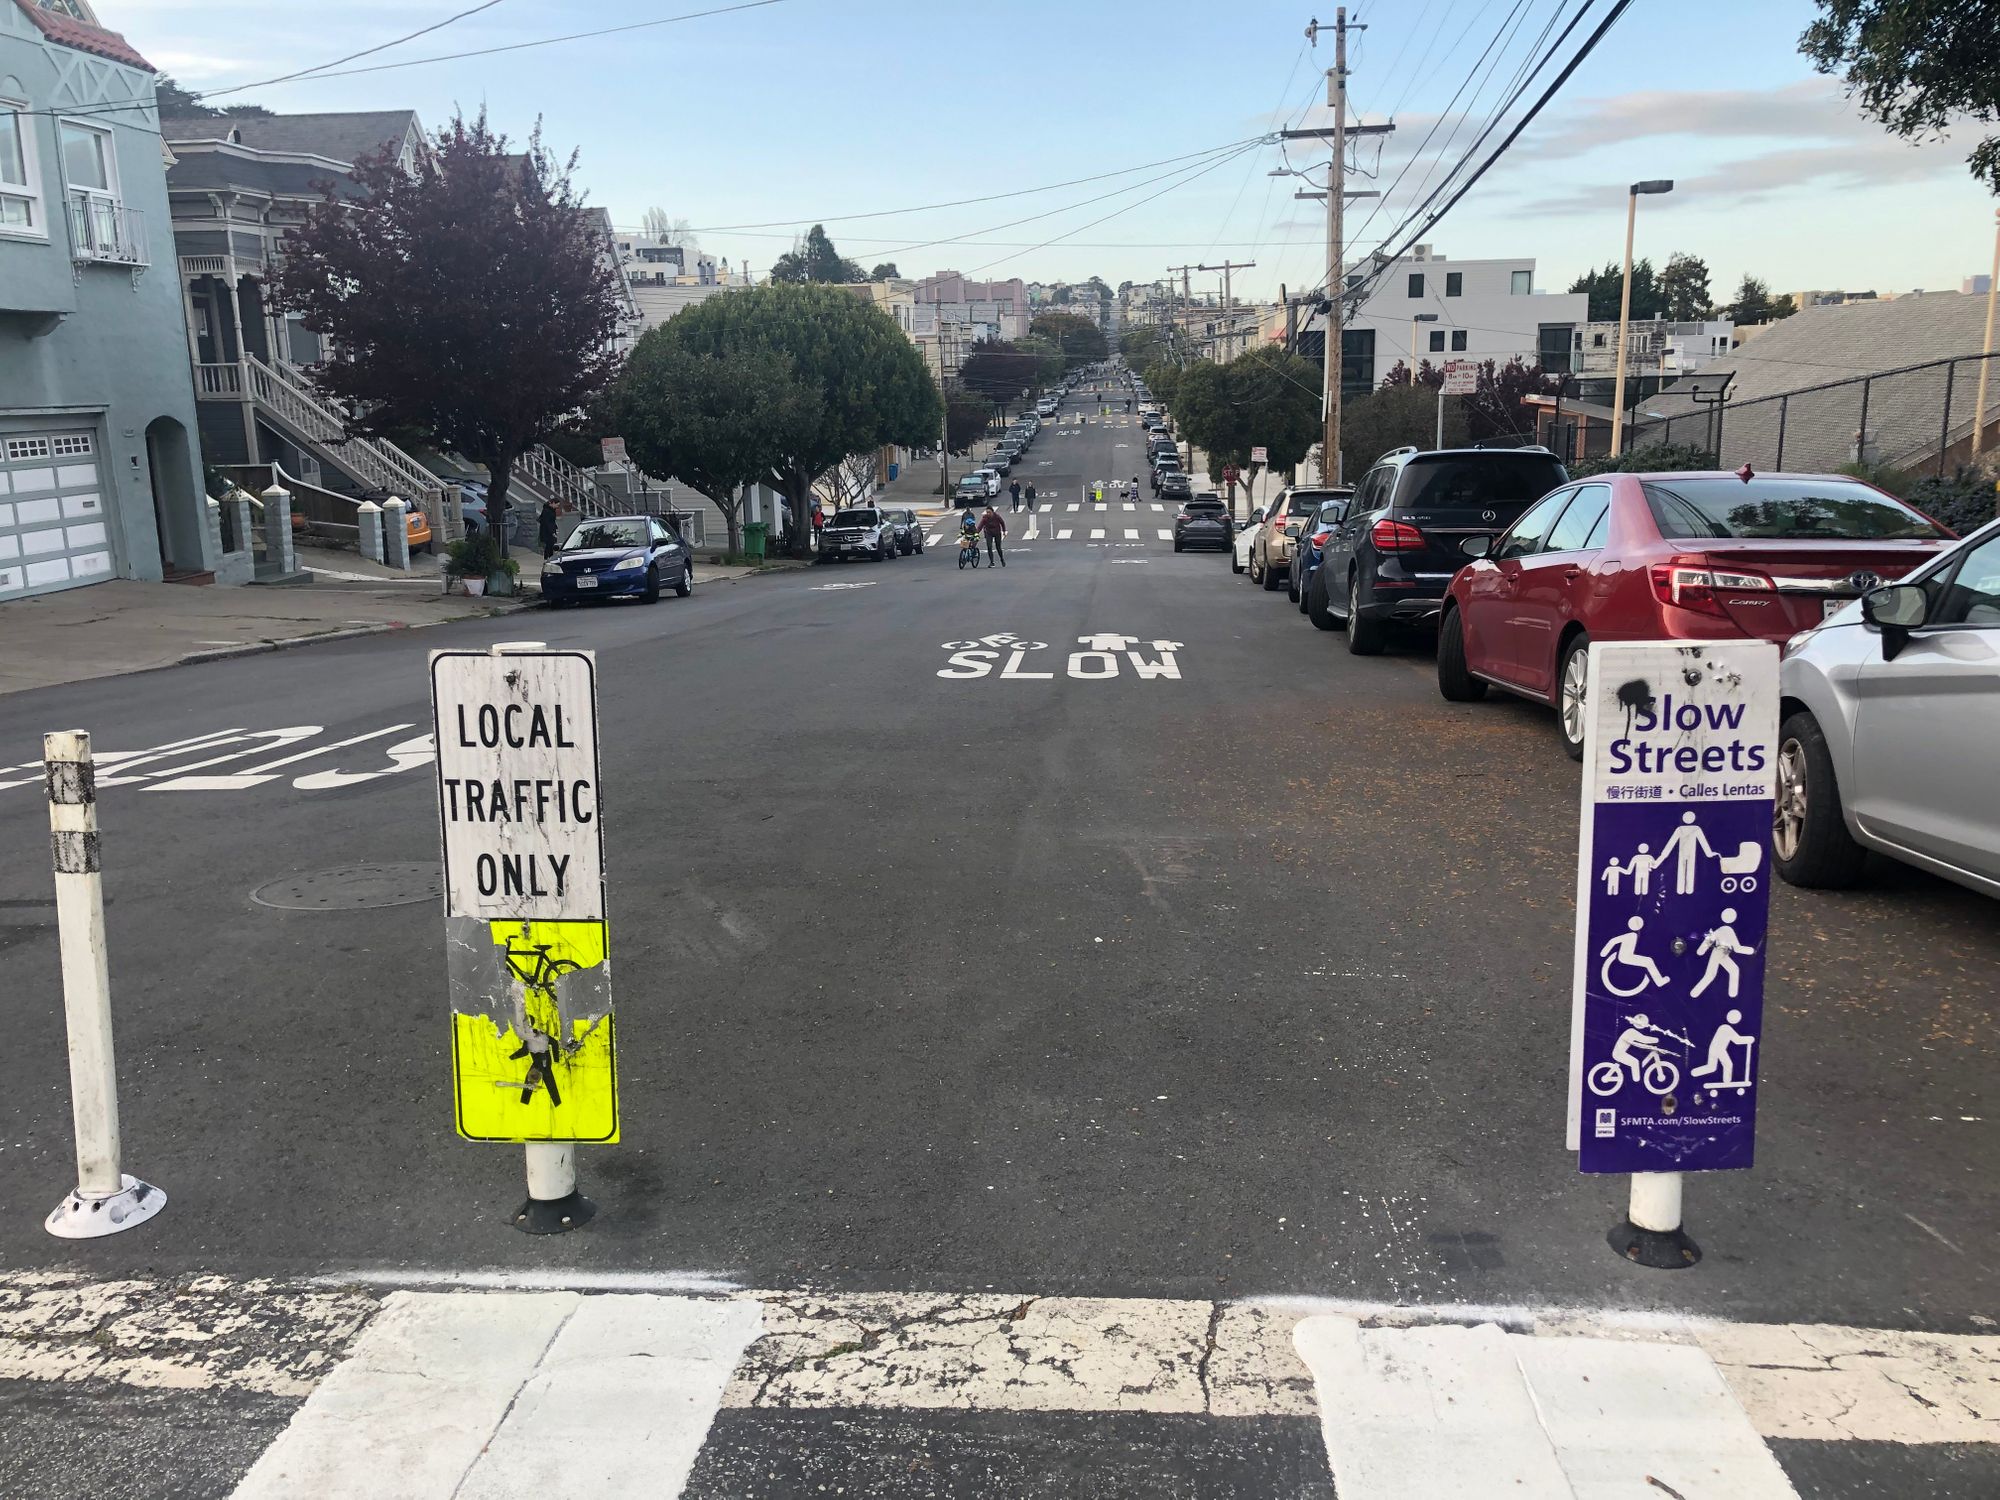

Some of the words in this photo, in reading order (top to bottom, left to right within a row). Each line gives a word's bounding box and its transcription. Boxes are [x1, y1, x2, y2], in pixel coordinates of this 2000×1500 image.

[1446, 363, 1456, 372] NO
[1223, 469, 1240, 477] STP
[936, 650, 1182, 679] SLOW
[457, 703, 575, 748] LOCAL
[1634, 693, 1746, 732] Slow
[1609, 738, 1766, 774] Streets
[444, 779, 593, 824] TRAFFIC
[1606, 785, 1662, 799] 慢行街道
[1679, 783, 1719, 798] Calles
[1722, 783, 1765, 797] Lentas
[476, 853, 571, 897] ONLY
[1620, 1115, 1741, 1127] SFMTA.com/SlowStreets
